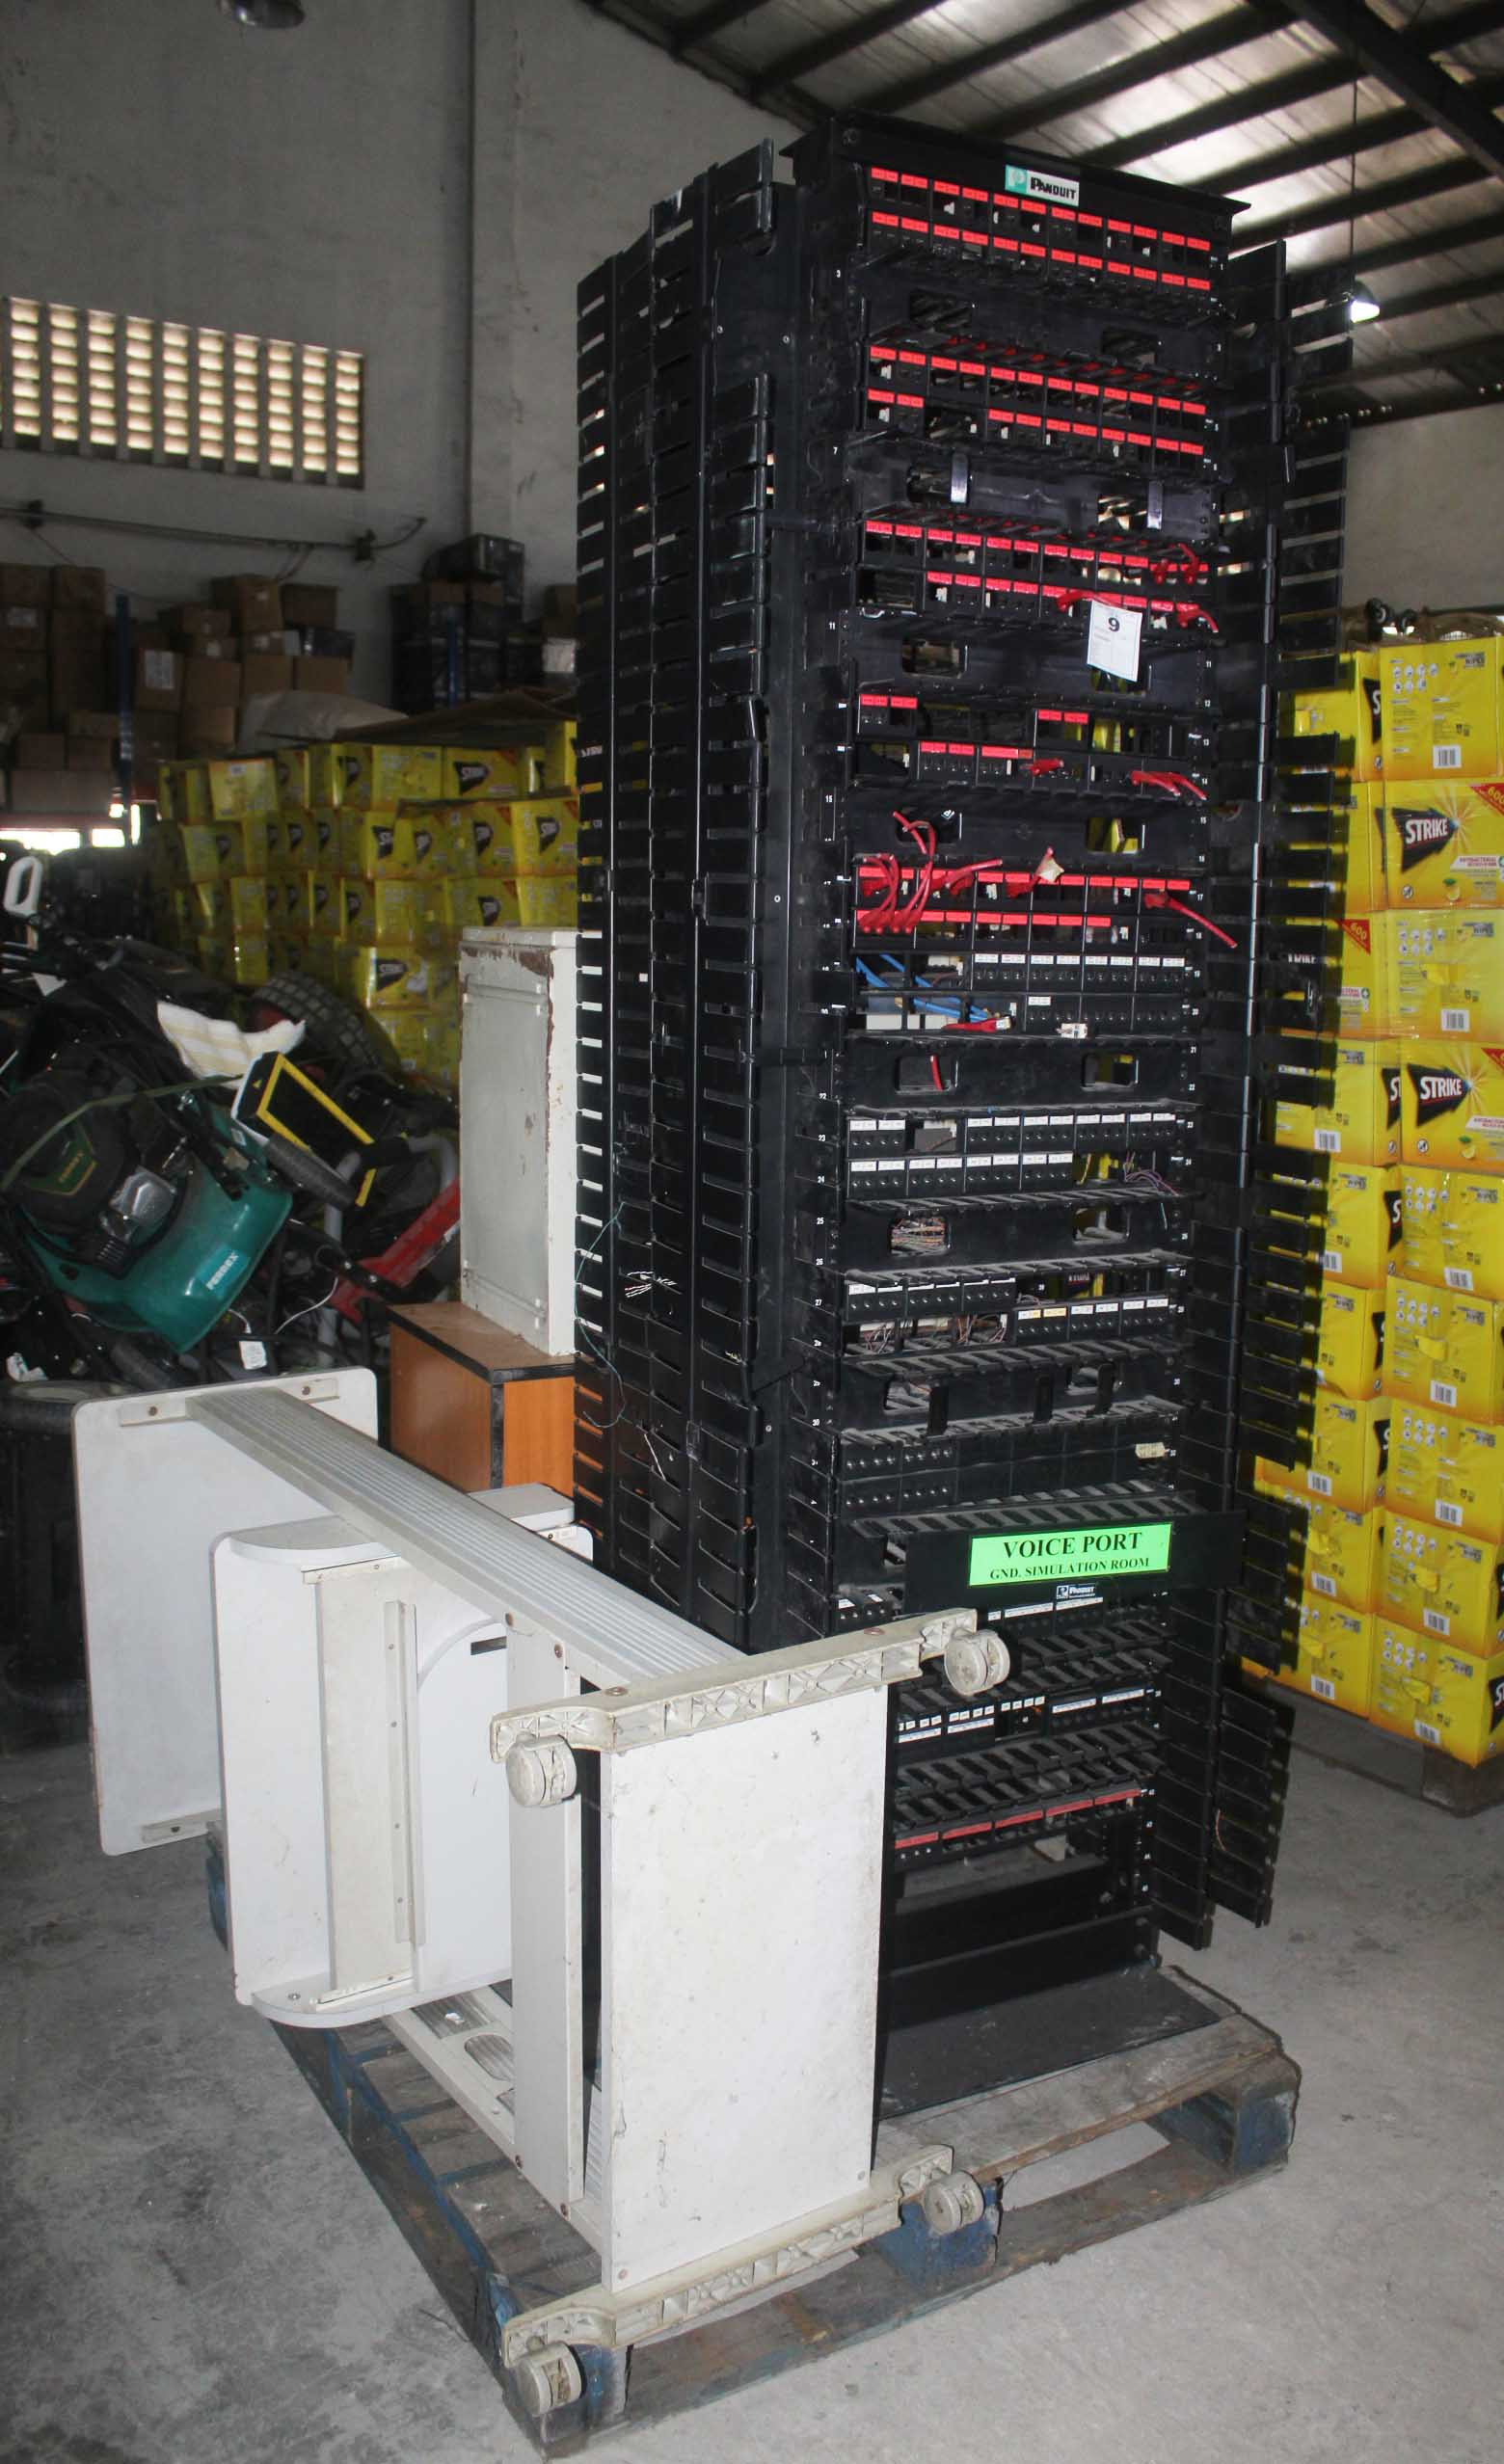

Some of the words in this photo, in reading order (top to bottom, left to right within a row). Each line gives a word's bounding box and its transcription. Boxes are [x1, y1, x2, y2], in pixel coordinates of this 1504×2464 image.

[1030, 177, 1076, 200] PANDUIT
[1108, 616, 1120, 632] 9
[1405, 817, 1448, 844] STRIKE
[1350, 922, 1368, 939] 600
[1419, 1075, 1463, 1101] STRIKE
[816, 1217, 824, 1225] 25
[1003, 1537, 1076, 1559] VOICE
[1082, 1531, 1142, 1554] PORT
[989, 1568, 1022, 1581] GND.
[1025, 1560, 1108, 1577] SIMULATION
[1110, 1557, 1150, 1571] ROOM
